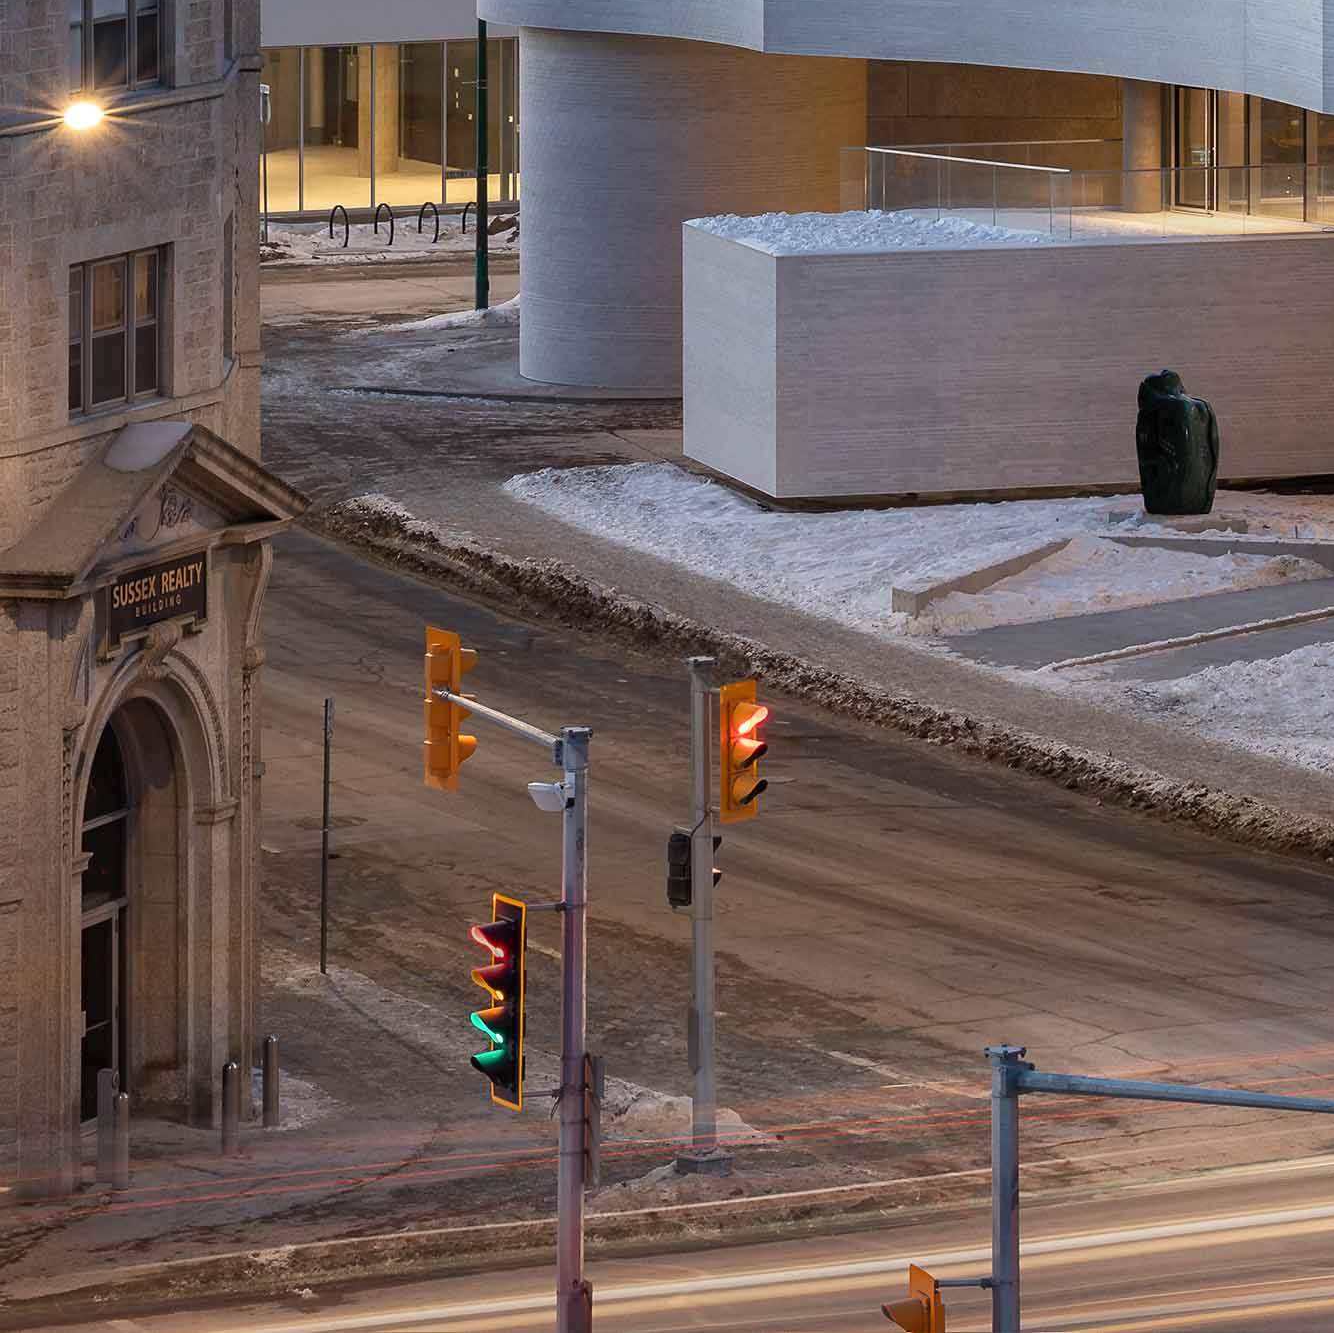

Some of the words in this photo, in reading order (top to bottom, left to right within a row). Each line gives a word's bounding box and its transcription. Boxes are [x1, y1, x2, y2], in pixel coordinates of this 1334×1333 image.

[113, 576, 156, 608] SUSSEX
[161, 561, 203, 594] REALTY
[136, 594, 182, 617] BUILDING
